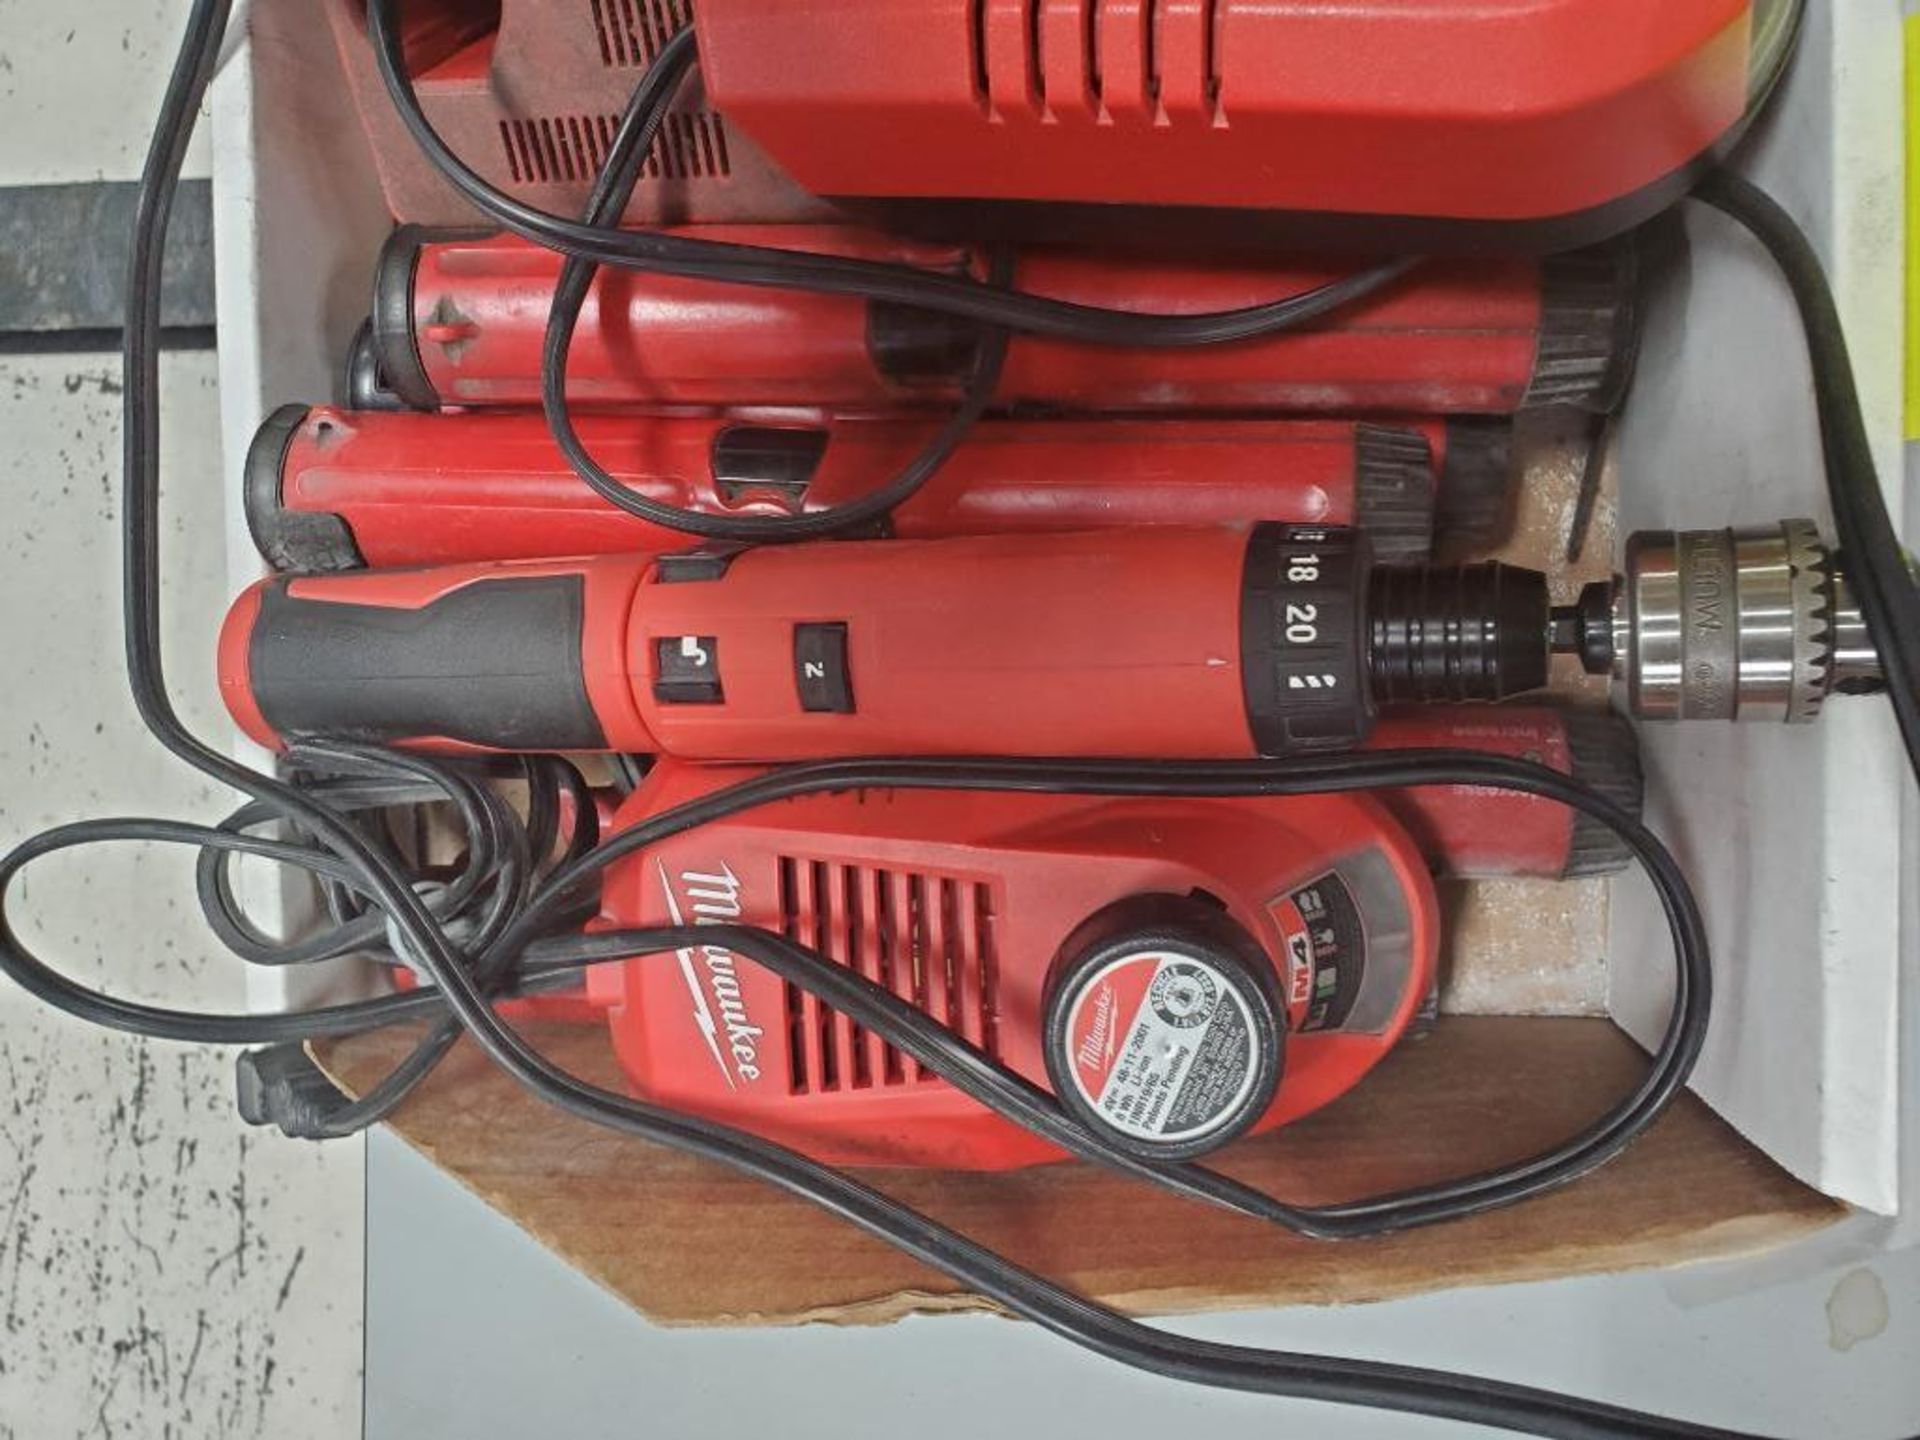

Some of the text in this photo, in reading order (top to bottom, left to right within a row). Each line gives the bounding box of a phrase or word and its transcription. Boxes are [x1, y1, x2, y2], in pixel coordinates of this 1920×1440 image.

[1287, 553, 1320, 582] 18
[1285, 603, 1318, 643] 20
[804, 661, 825, 679] 2
[681, 860, 763, 1084] Miwaukee
[1293, 936, 1309, 999] M4
[1077, 985, 1112, 1072] Milwaukee
[1117, 1023, 1151, 1084] 48-11-2001
[1142, 1046, 1190, 1131] Patents Pending
